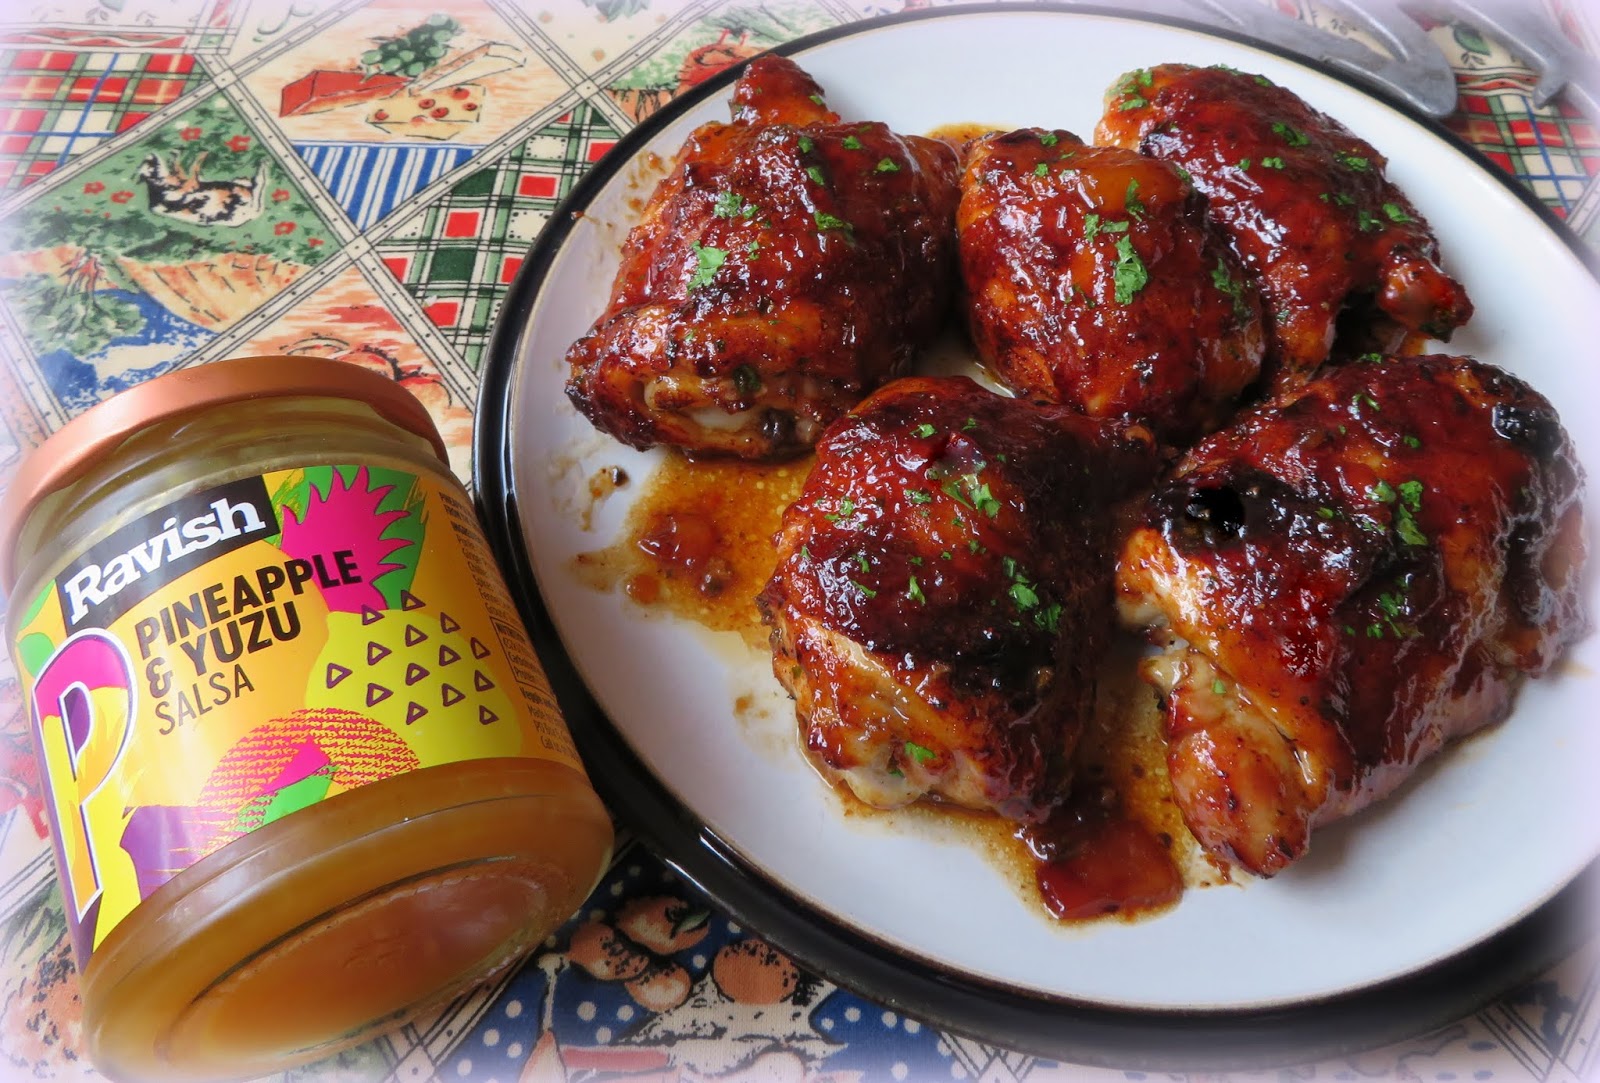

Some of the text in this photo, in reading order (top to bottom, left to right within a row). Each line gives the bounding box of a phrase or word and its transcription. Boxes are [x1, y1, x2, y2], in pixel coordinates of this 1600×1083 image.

[63, 497, 267, 626] Ravish
[135, 550, 363, 660] PINEAPPLE
[146, 600, 301, 698] & YUZU
[155, 663, 255, 736] SALSA
